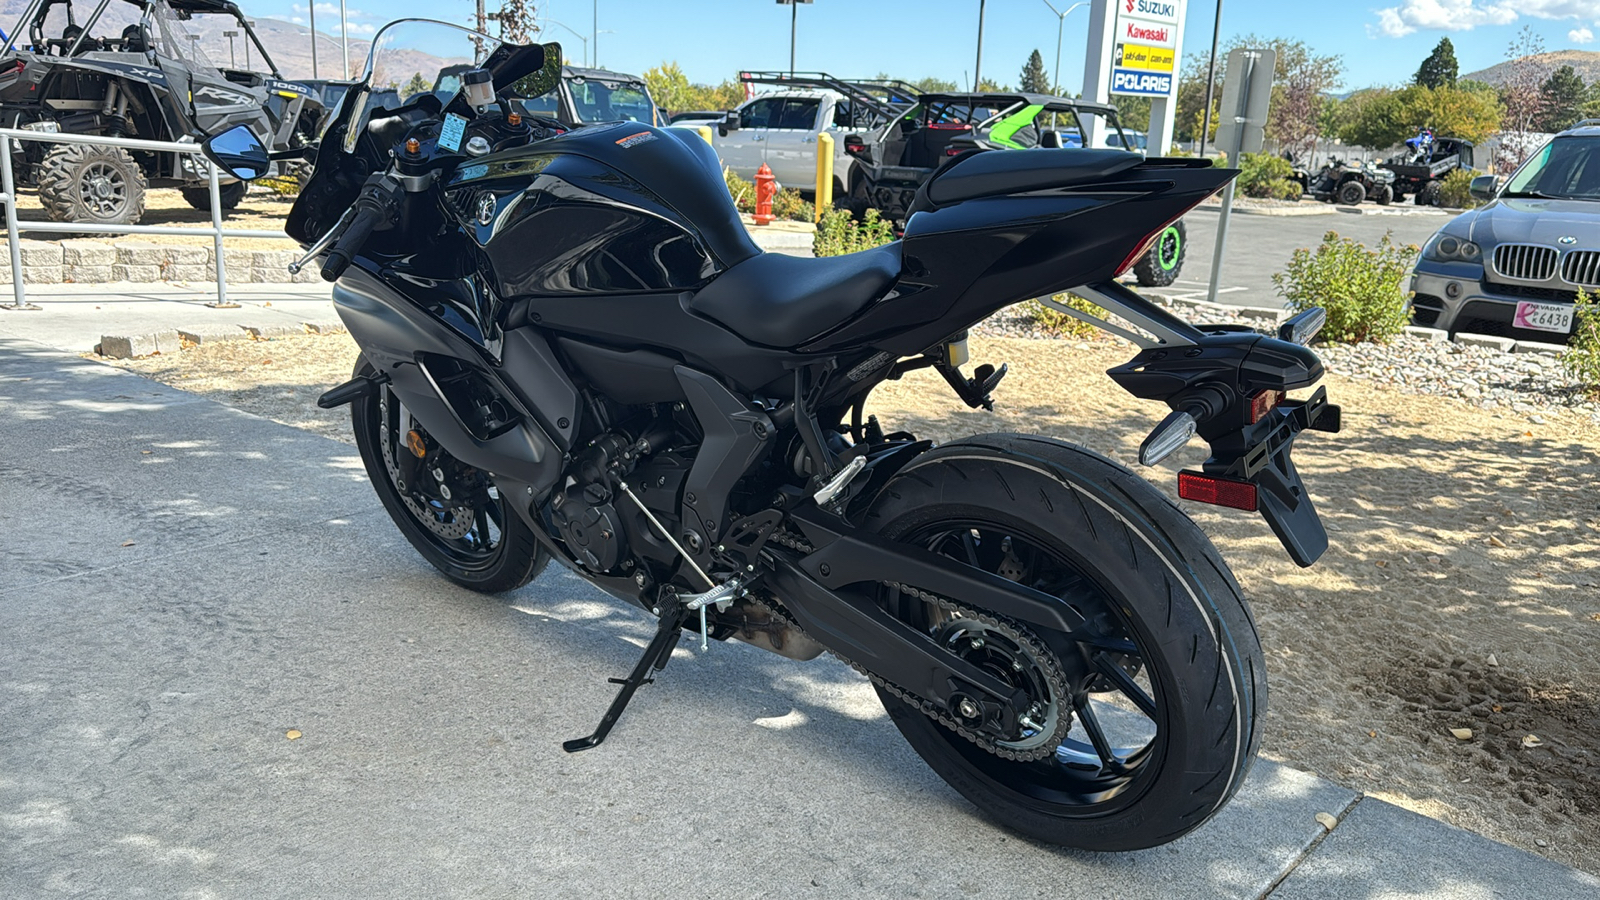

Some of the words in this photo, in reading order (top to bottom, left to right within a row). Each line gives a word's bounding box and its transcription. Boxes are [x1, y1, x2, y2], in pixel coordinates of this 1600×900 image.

[1137, 0, 1175, 17] SUZUKI
[1127, 23, 1168, 42] Kawasaki
[129, 68, 164, 79] XP
[272, 81, 307, 94] 1000
[1114, 72, 1170, 92] POLARIS
[195, 86, 256, 107] RZR
[1530, 303, 1560, 312] NEVADA
[1539, 312, 1569, 327] 6438
